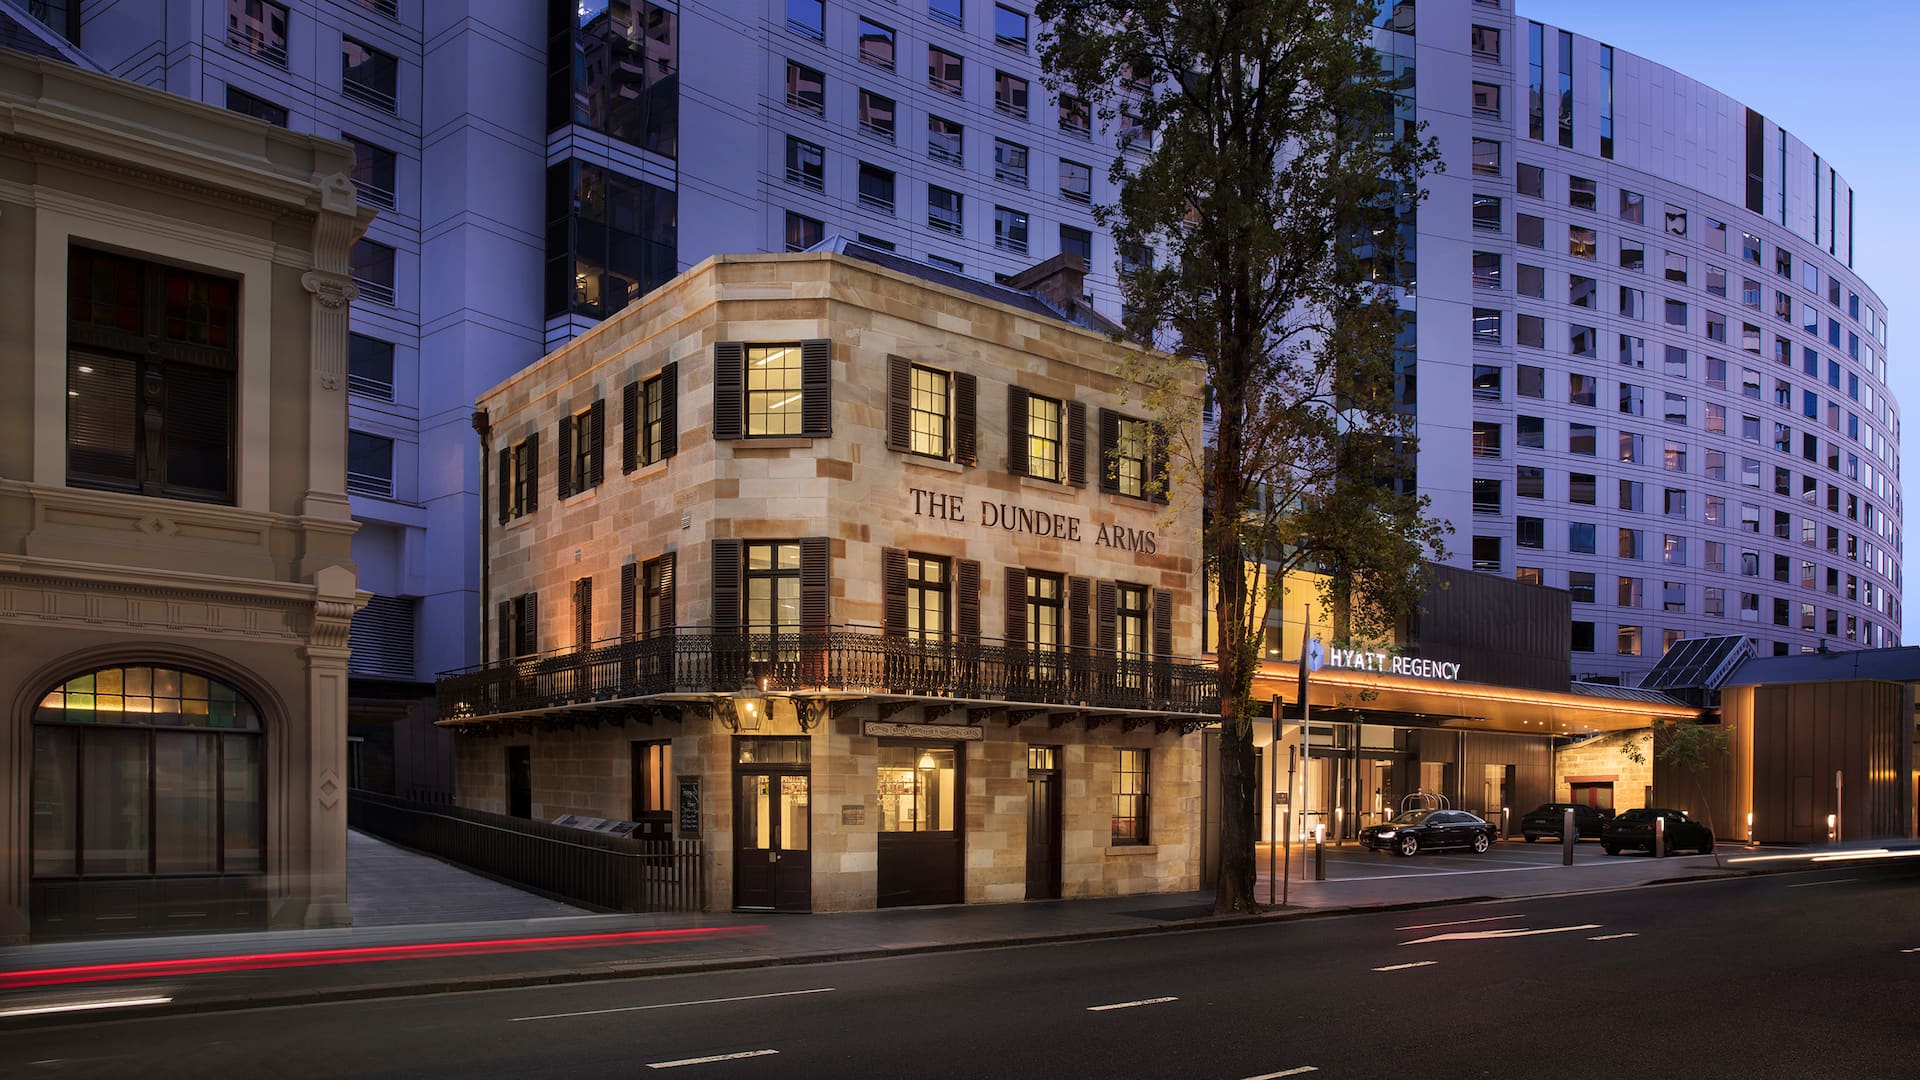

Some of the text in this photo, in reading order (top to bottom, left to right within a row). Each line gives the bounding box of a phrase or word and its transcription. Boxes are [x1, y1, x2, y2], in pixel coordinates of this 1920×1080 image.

[910, 488, 1157, 555] THE DUNDEE ARMS
[1330, 647, 1461, 680] HYATT REGENCY
